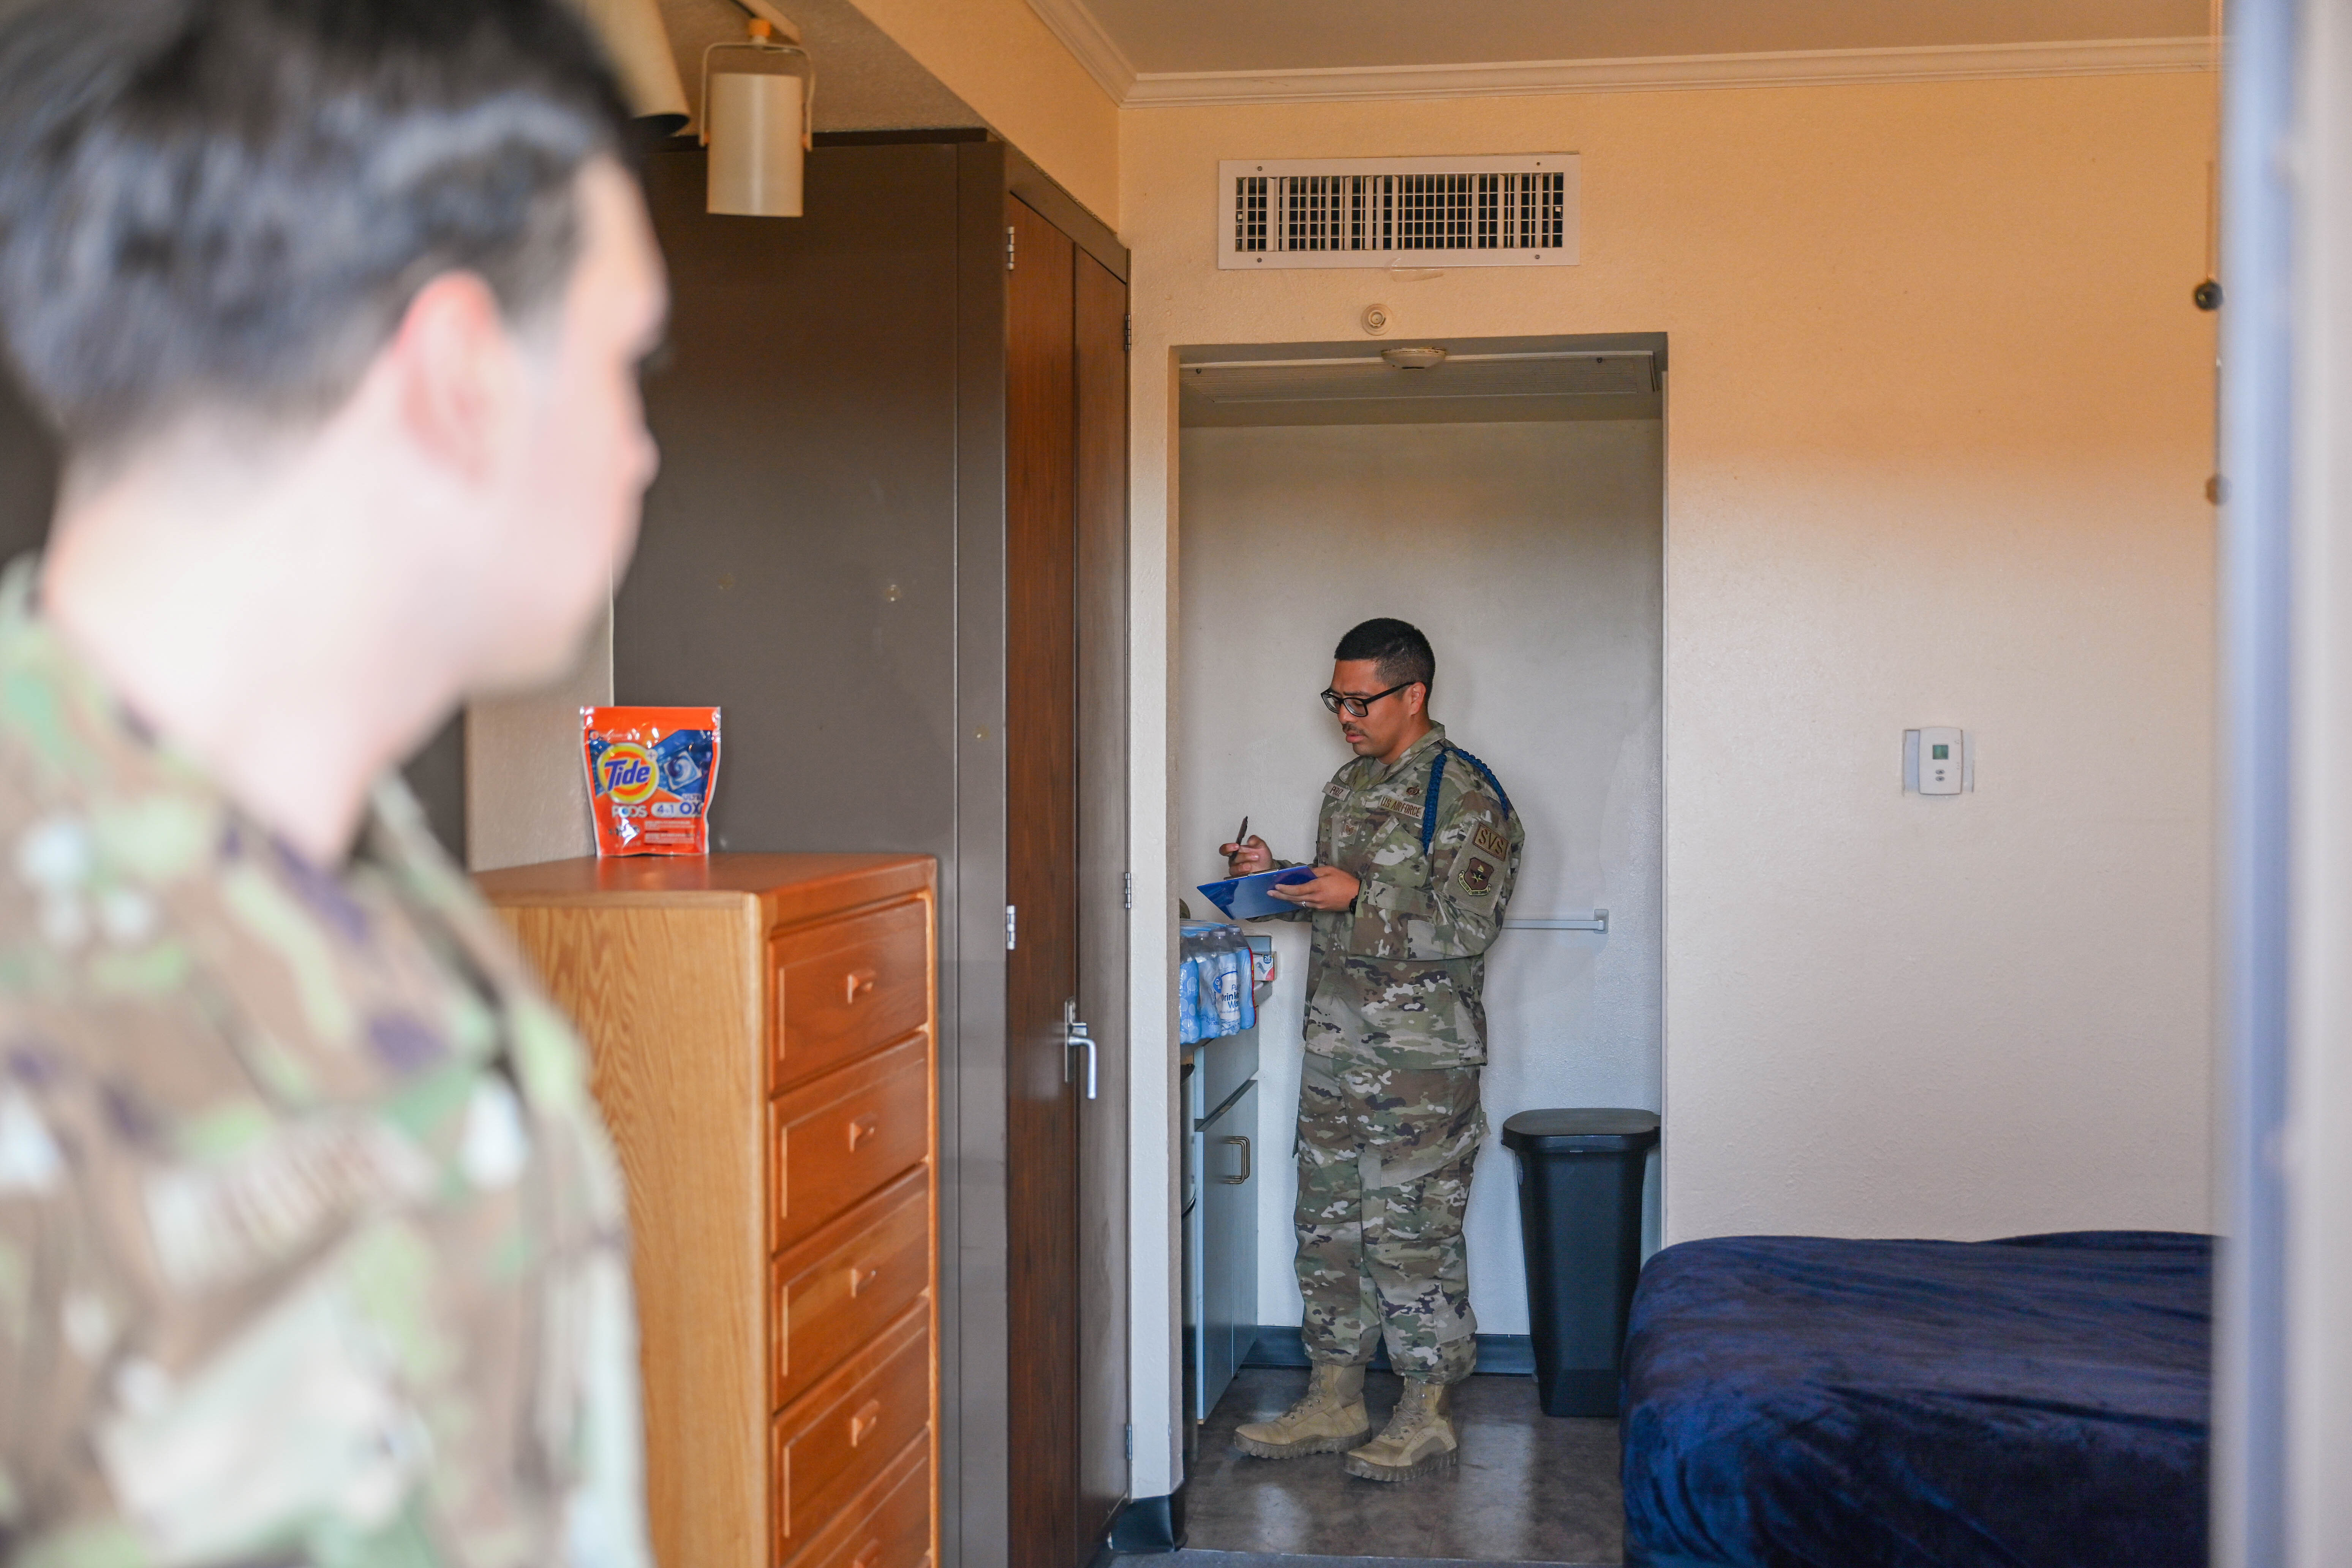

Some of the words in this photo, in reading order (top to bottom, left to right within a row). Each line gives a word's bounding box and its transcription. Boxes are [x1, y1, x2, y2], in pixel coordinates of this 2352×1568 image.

[605, 759, 651, 791] Tide
[1391, 800, 1402, 811] AIR
[1400, 803, 1422, 817] FORCE
[1478, 828, 1503, 855] SVS
